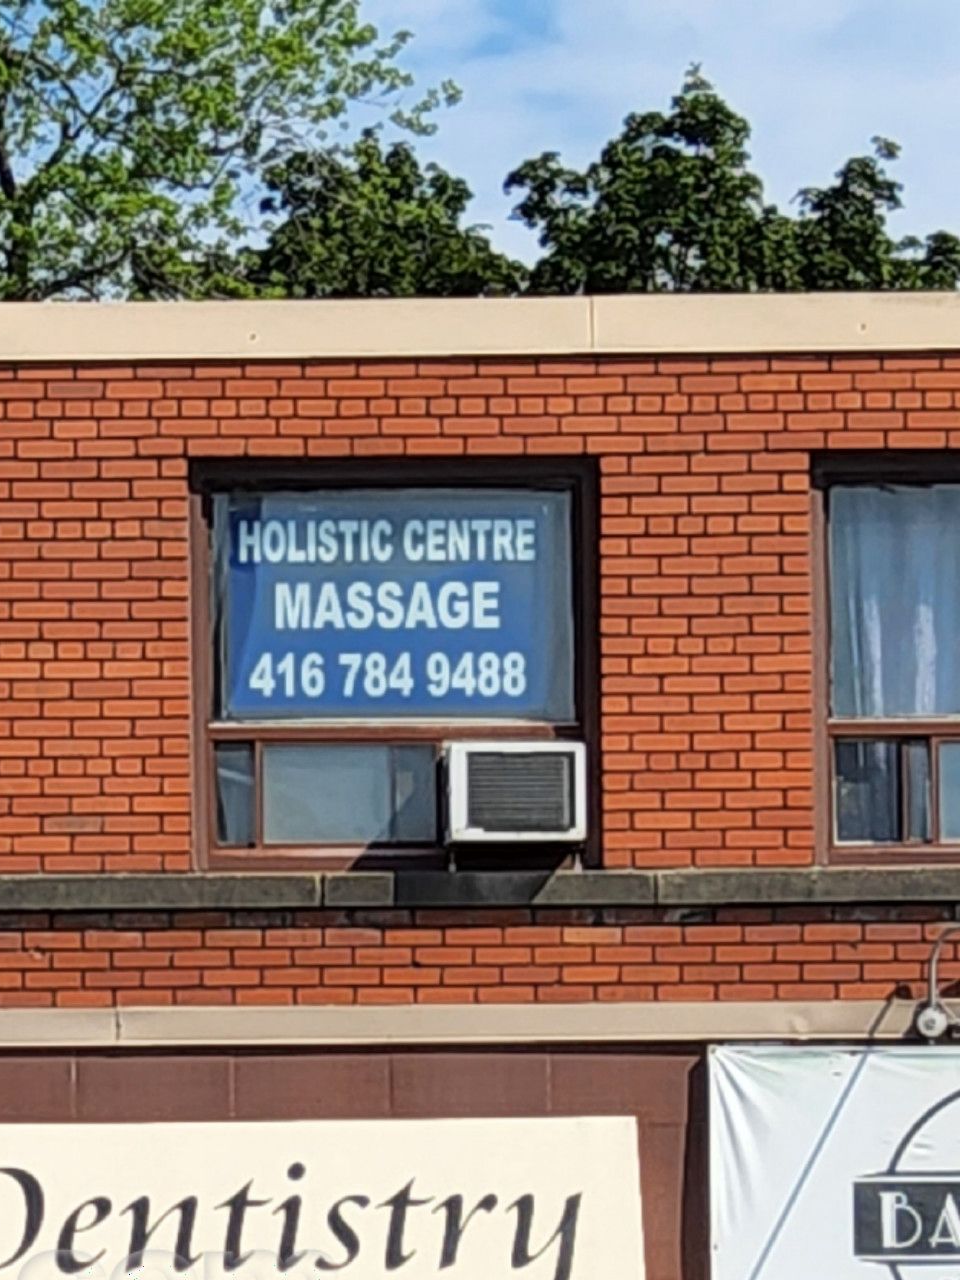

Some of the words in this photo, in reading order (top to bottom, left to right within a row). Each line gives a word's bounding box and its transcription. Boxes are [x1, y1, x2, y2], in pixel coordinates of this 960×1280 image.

[239, 518, 393, 562] HOLISTIC
[403, 518, 536, 561] CENTRE
[274, 580, 500, 629] MASSAGE
[249, 651, 325, 698] 416
[339, 651, 414, 697] 784
[426, 651, 527, 697] 9488
